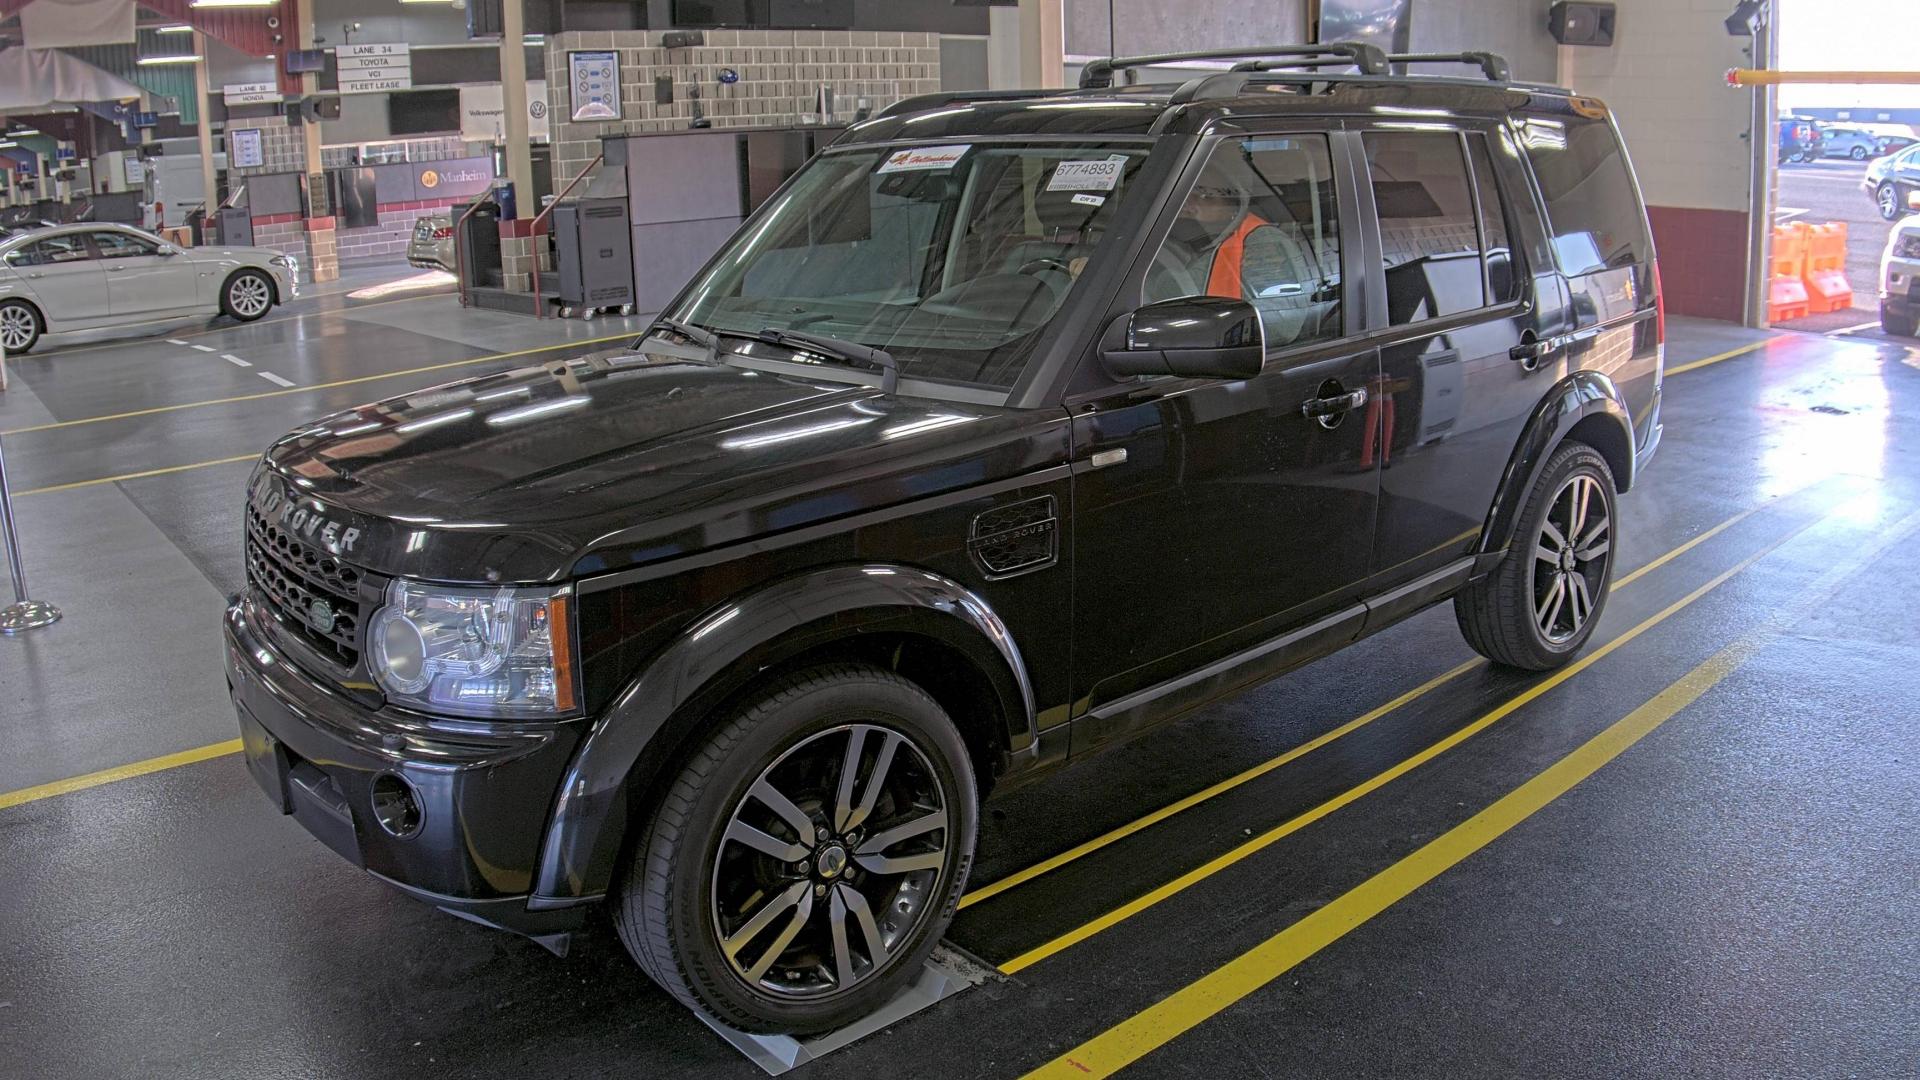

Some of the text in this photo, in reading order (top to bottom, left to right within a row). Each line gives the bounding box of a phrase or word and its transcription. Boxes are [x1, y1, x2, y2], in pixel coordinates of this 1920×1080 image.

[360, 59, 389, 67] TOYOTA
[350, 82, 374, 90] FLEET
[1056, 163, 1115, 176] 6774893
[440, 170, 487, 184] Manheim
[281, 499, 360, 554] ROVER
